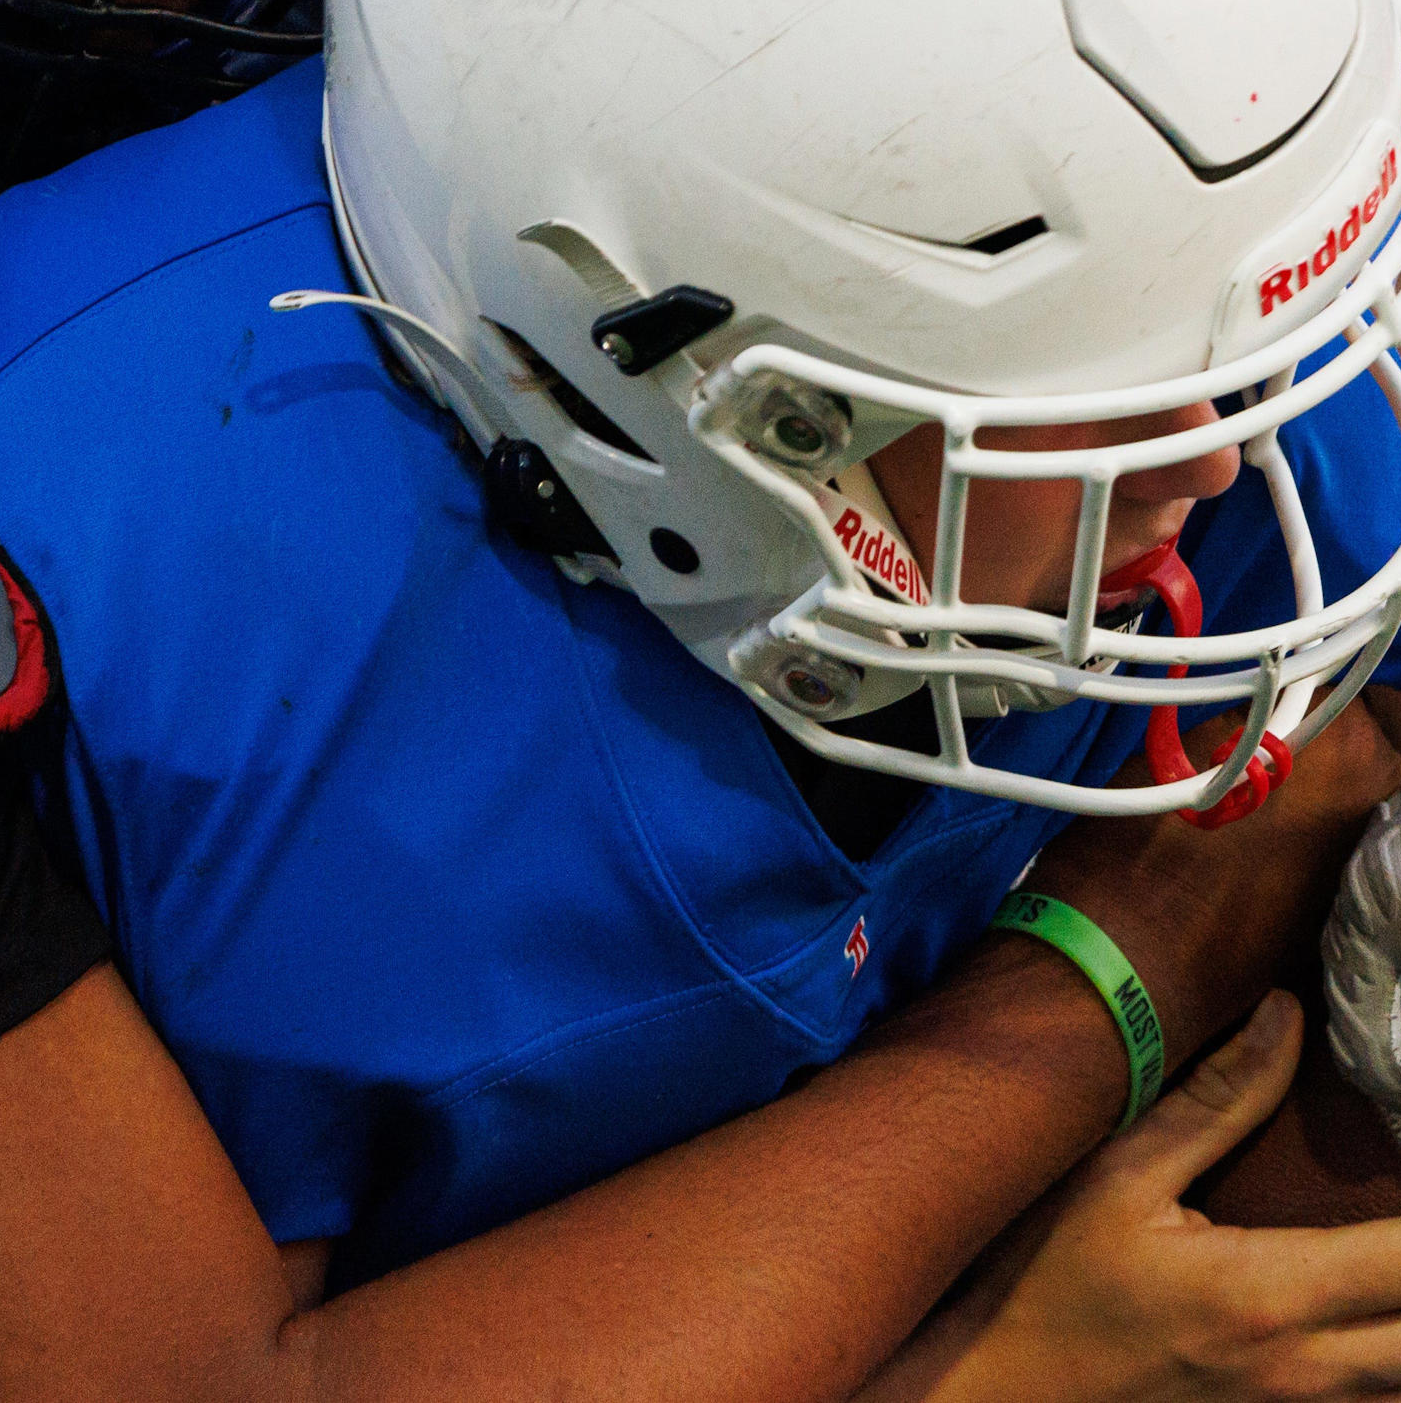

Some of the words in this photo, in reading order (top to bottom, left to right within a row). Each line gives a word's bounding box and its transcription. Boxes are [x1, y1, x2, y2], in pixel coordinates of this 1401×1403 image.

[1258, 142, 1398, 318] Riddell
[832, 507, 924, 606] Riddell
[1114, 974, 1161, 1056] MOST
